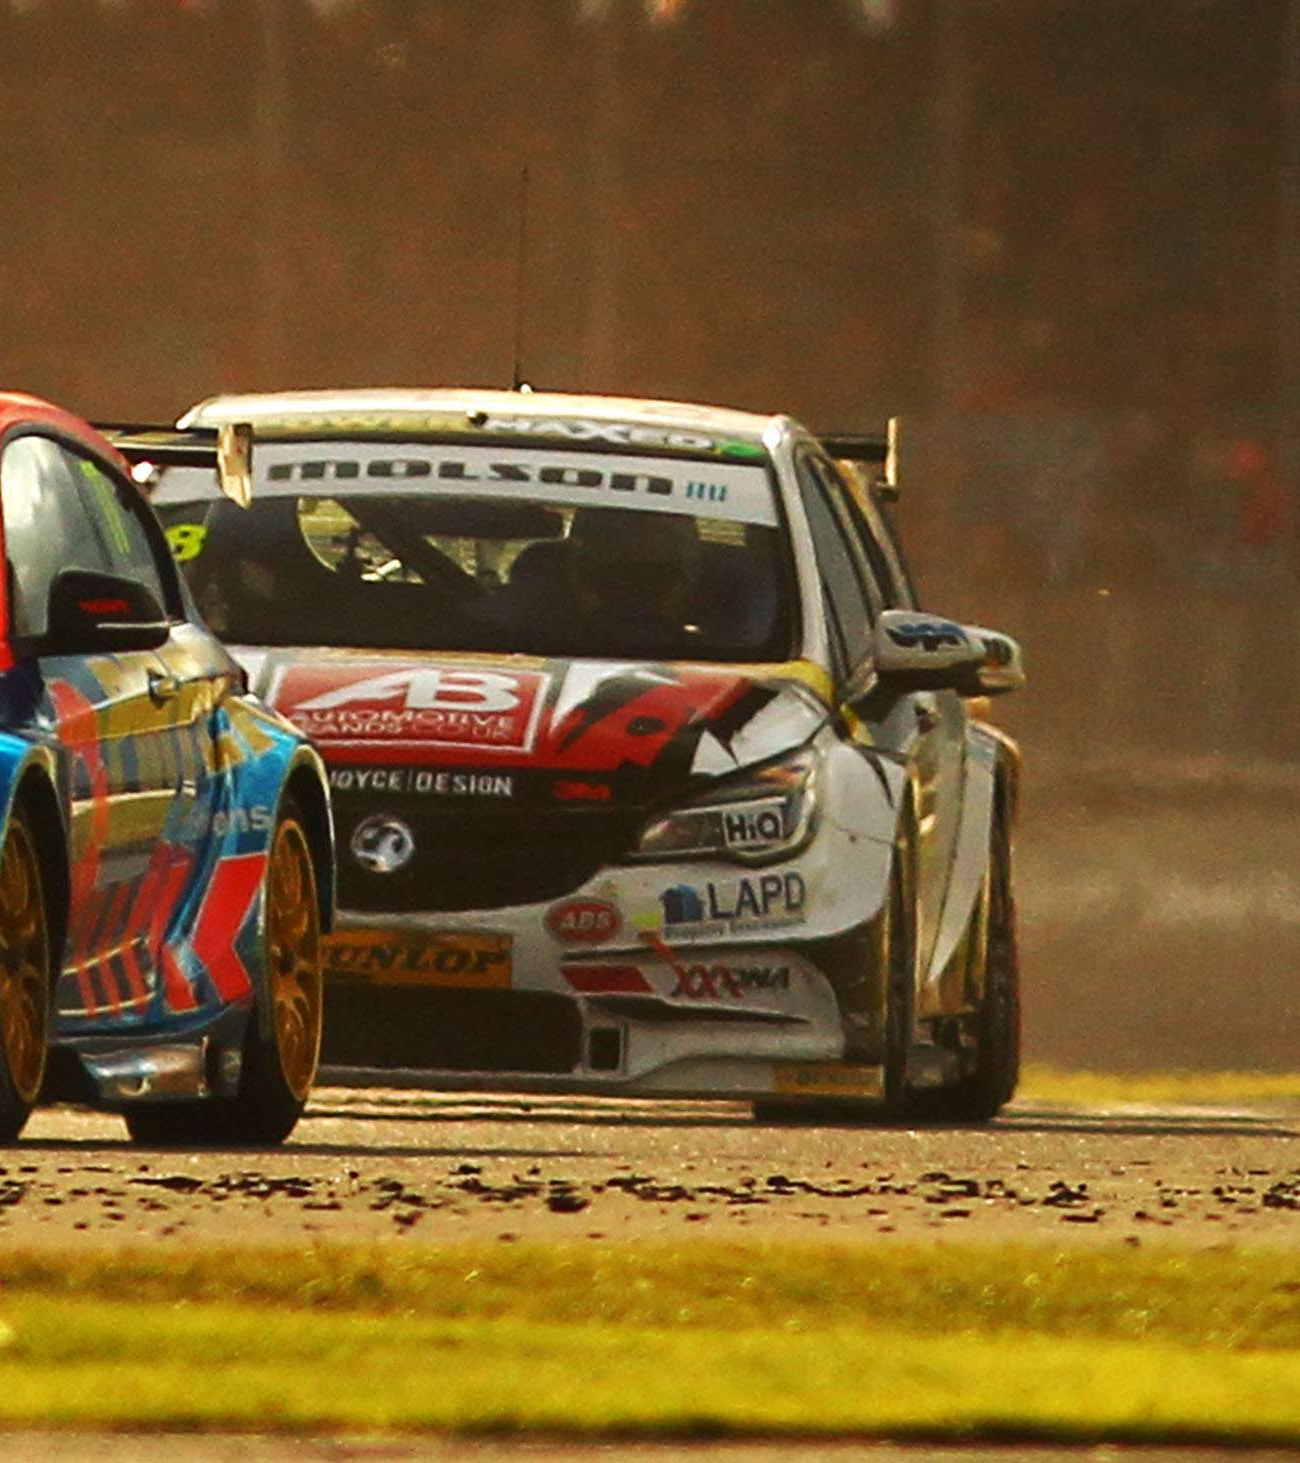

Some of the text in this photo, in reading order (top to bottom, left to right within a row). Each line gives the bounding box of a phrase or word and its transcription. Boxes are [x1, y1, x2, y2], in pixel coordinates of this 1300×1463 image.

[294, 667, 521, 713] AB
[415, 773, 513, 797] DESIGN
[726, 811, 781, 841] HiQ
[707, 871, 806, 919] LAPD
